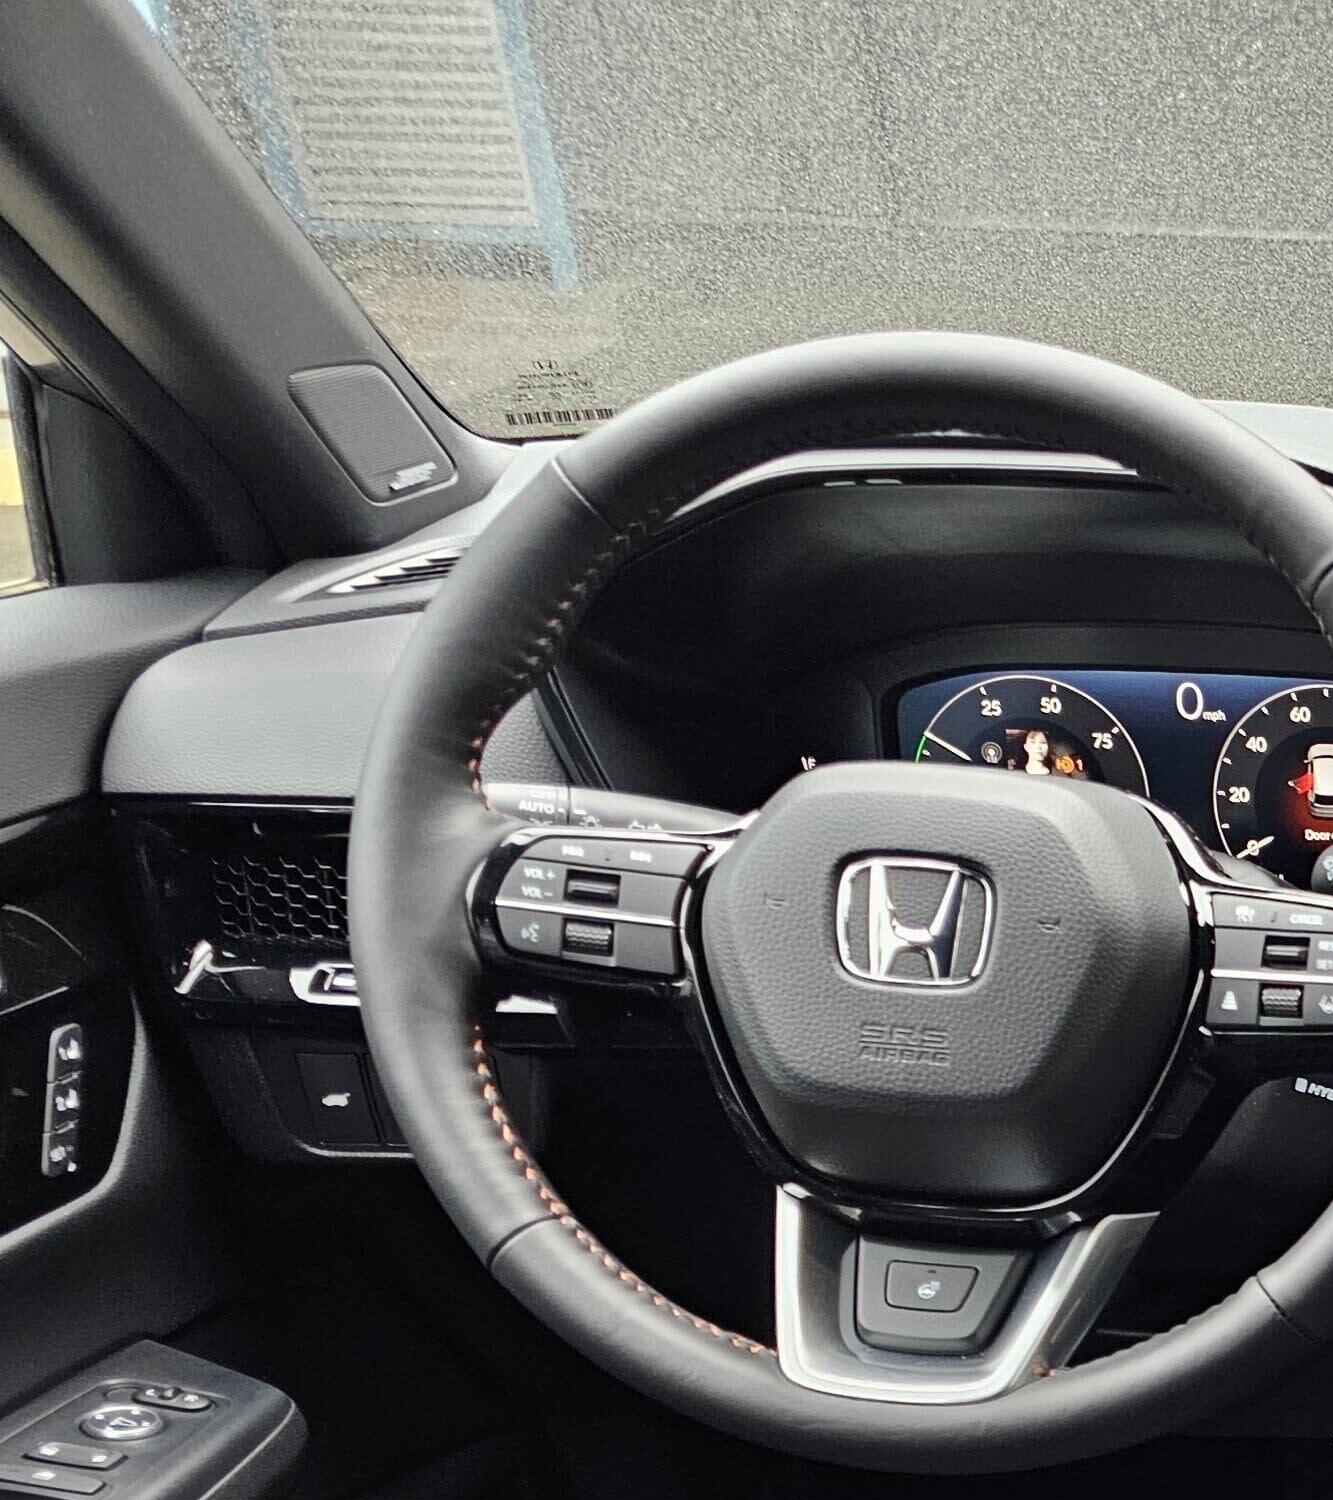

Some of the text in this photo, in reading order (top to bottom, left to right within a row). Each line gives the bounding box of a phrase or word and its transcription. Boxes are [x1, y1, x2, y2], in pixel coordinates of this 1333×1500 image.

[980, 699, 1003, 717] 25
[1040, 696, 1062, 715] 50
[1176, 682, 1227, 722] 0 mph
[1289, 706, 1311, 723] 60
[1091, 732, 1114, 750] 75
[1245, 736, 1268, 753] 40
[1228, 786, 1250, 803] 20
[518, 800, 555, 815] AUTO
[1304, 828, 1331, 841] Door
[859, 1022, 948, 1049] SRS
[858, 1045, 950, 1066] AIRBAG
